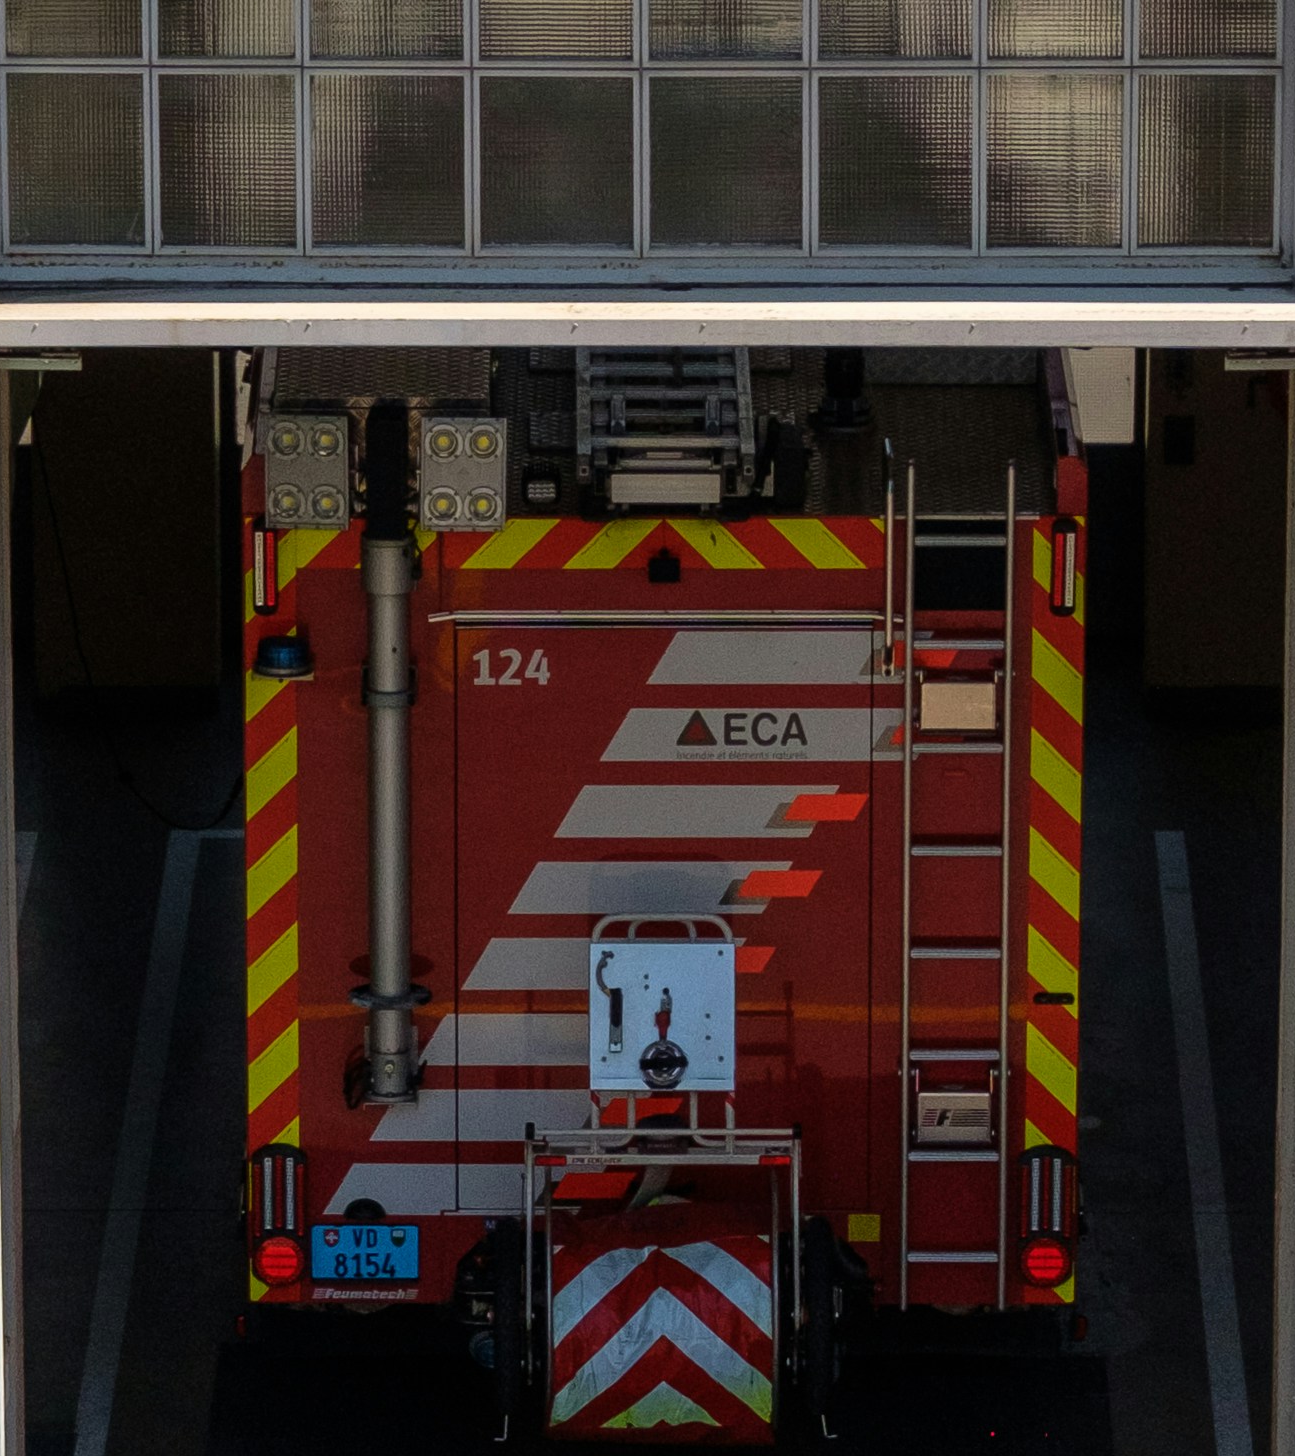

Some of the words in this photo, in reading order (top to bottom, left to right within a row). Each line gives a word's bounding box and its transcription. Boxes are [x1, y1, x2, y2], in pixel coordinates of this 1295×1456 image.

[472, 648, 551, 686] 124
[723, 712, 808, 746] ECA
[676, 750, 715, 760] Incendie
[717, 750, 726, 760] et
[352, 1229, 378, 1248] VD
[334, 1253, 397, 1277] 8154
